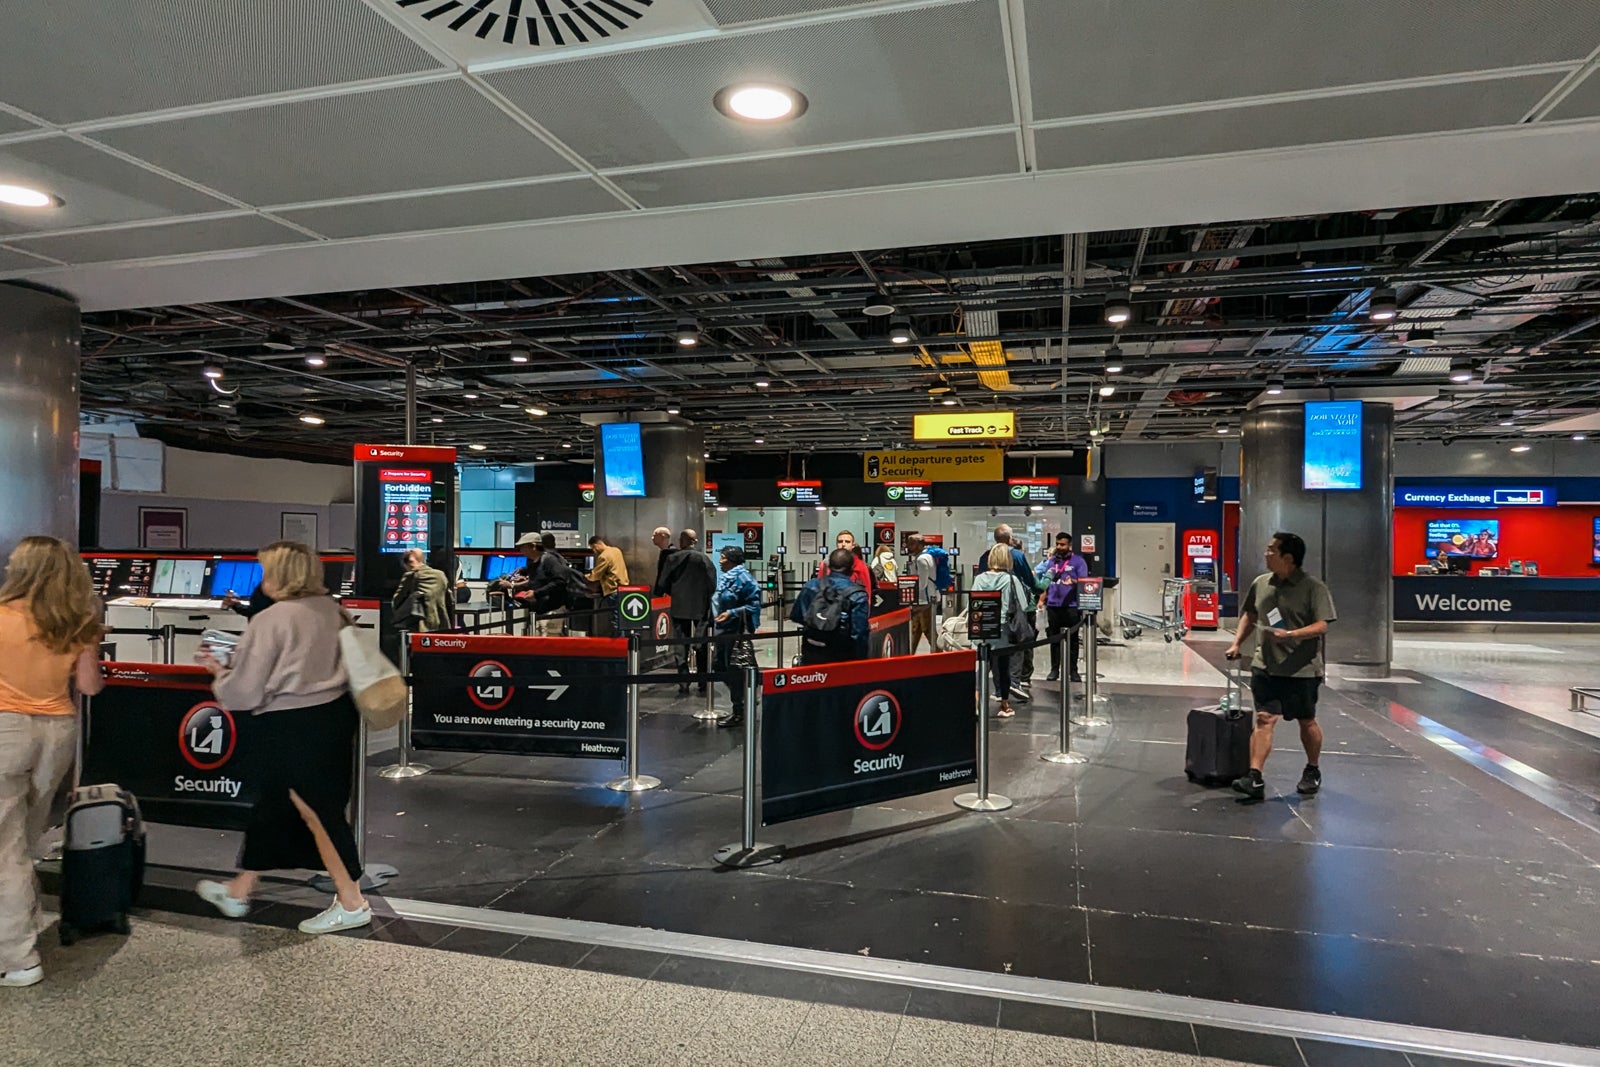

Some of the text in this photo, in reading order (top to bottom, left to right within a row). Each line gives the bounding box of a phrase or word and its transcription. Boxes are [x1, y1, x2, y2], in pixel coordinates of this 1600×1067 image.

[964, 426, 983, 434] Track
[882, 455, 985, 467] All departure gates
[882, 467, 925, 477] Security
[384, 484, 431, 492] Forbidden
[1404, 493, 1491, 503] Currency Exchange
[1415, 594, 1512, 612] Welcome
[434, 638, 467, 649] Security
[790, 672, 828, 685] Security
[433, 714, 605, 730] You are now entering a security zone
[581, 743, 620, 753] Heathrow
[853, 753, 905, 775] Security
[939, 768, 973, 781] Heathrow
[174, 775, 242, 798] Security
